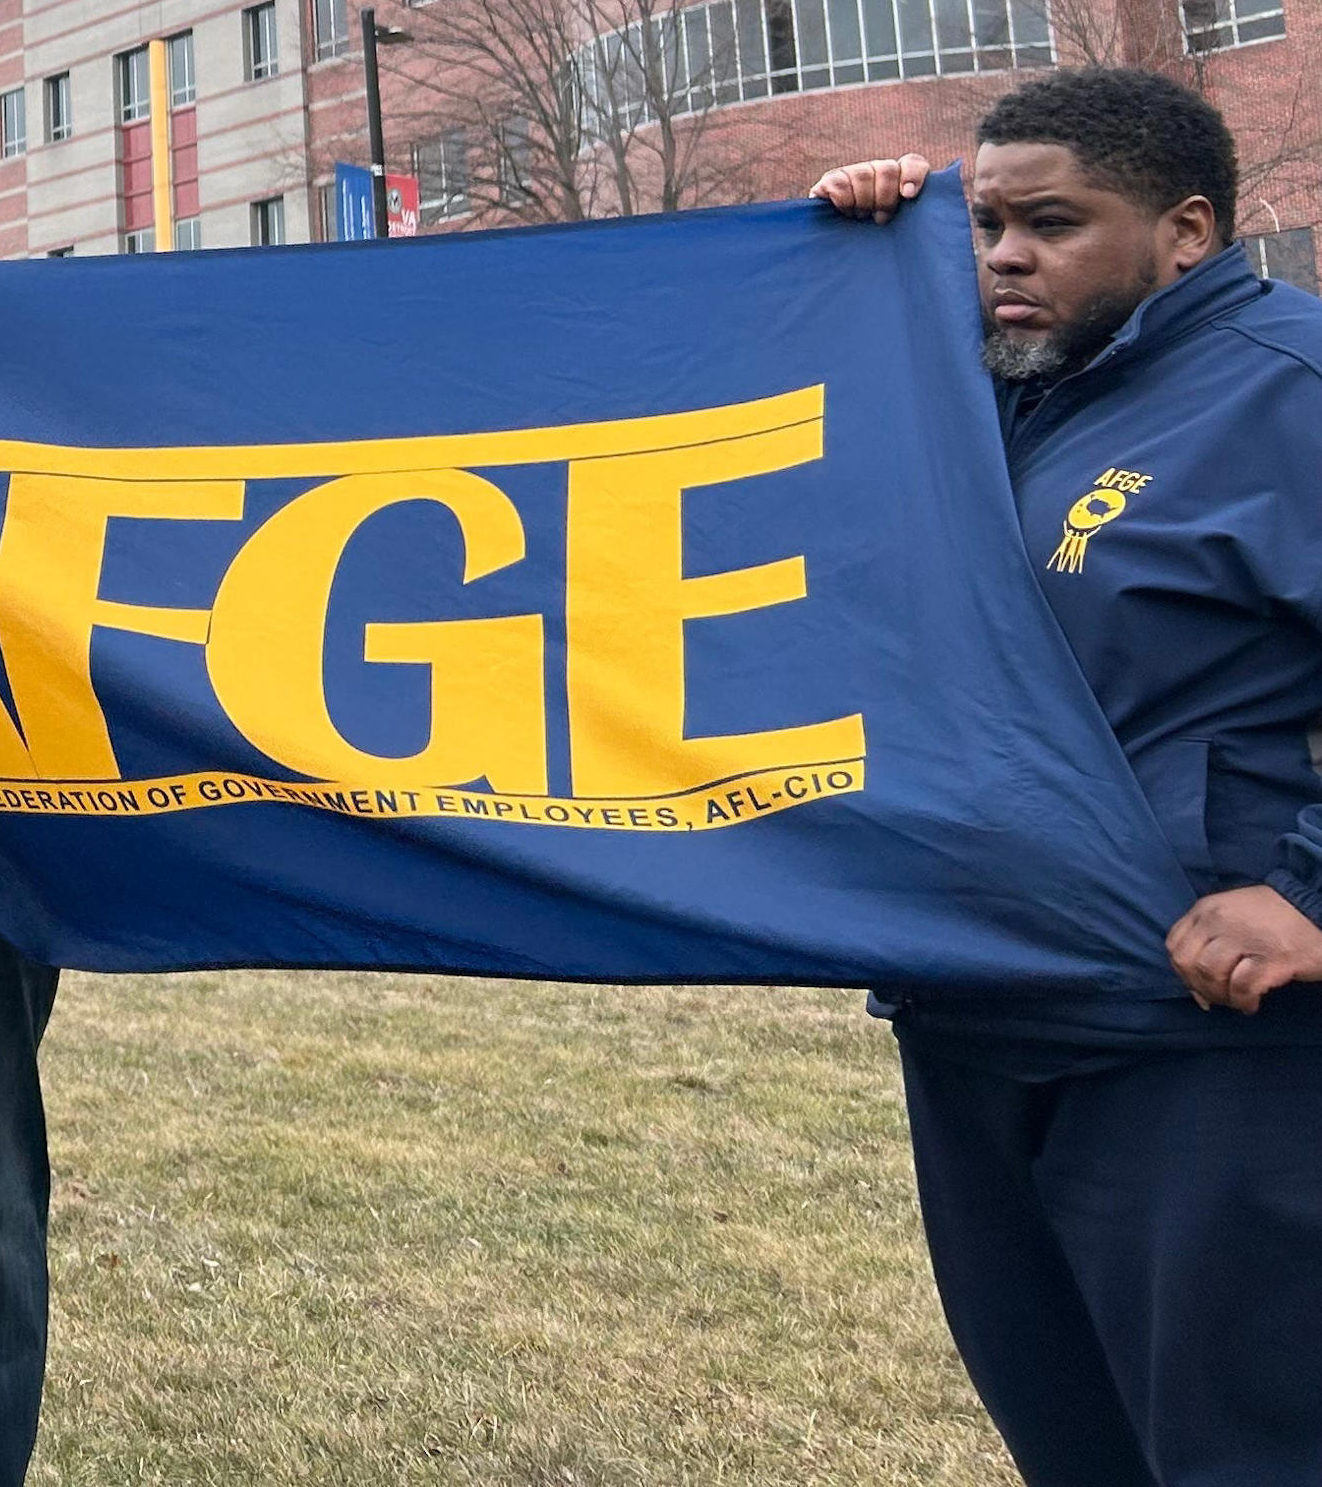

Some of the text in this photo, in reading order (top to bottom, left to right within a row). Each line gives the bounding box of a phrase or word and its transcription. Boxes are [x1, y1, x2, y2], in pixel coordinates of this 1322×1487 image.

[1093, 468, 1154, 494] AFGE
[147, 784, 187, 808] OF
[198, 778, 421, 814] GOVERNMENT
[436, 794, 694, 832] EMPLOYEES,
[706, 770, 854, 824] AFL-CIO
